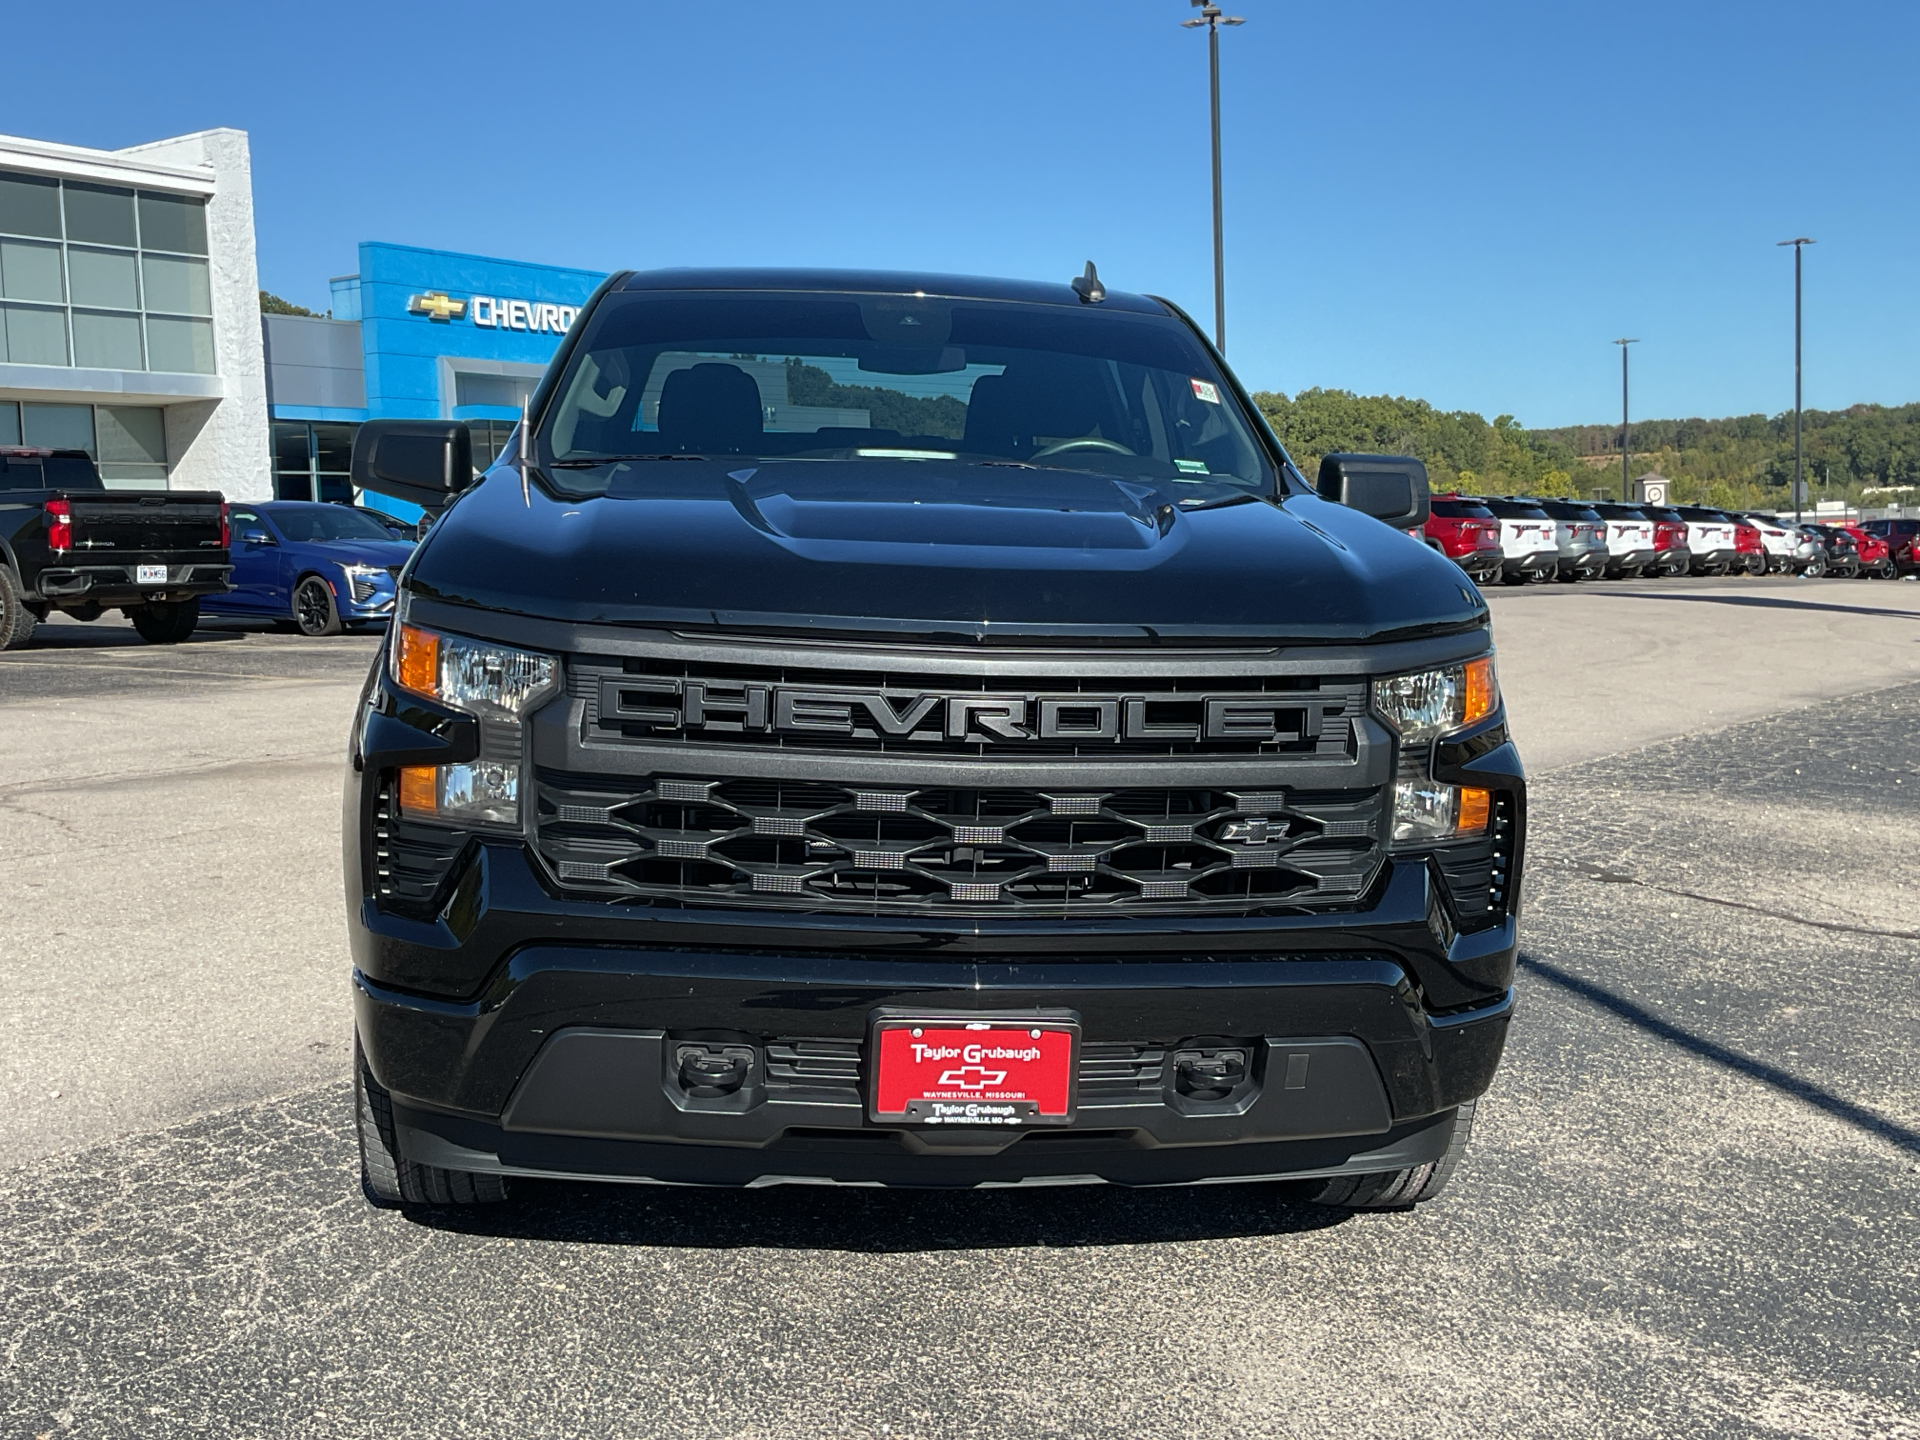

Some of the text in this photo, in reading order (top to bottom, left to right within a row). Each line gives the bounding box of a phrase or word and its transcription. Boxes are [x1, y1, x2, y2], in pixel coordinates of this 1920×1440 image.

[472, 296, 583, 334] CHEVRO
[599, 675, 1348, 741] CHEVROLET
[910, 1043, 1041, 1063] Taylor Grubaugh
[923, 1091, 1026, 1099] WAYNESVILLE, MISSOURI
[932, 1103, 1015, 1117] Taylor Grubaugh
[944, 1116, 991, 1124] WAYNESVILLE,
